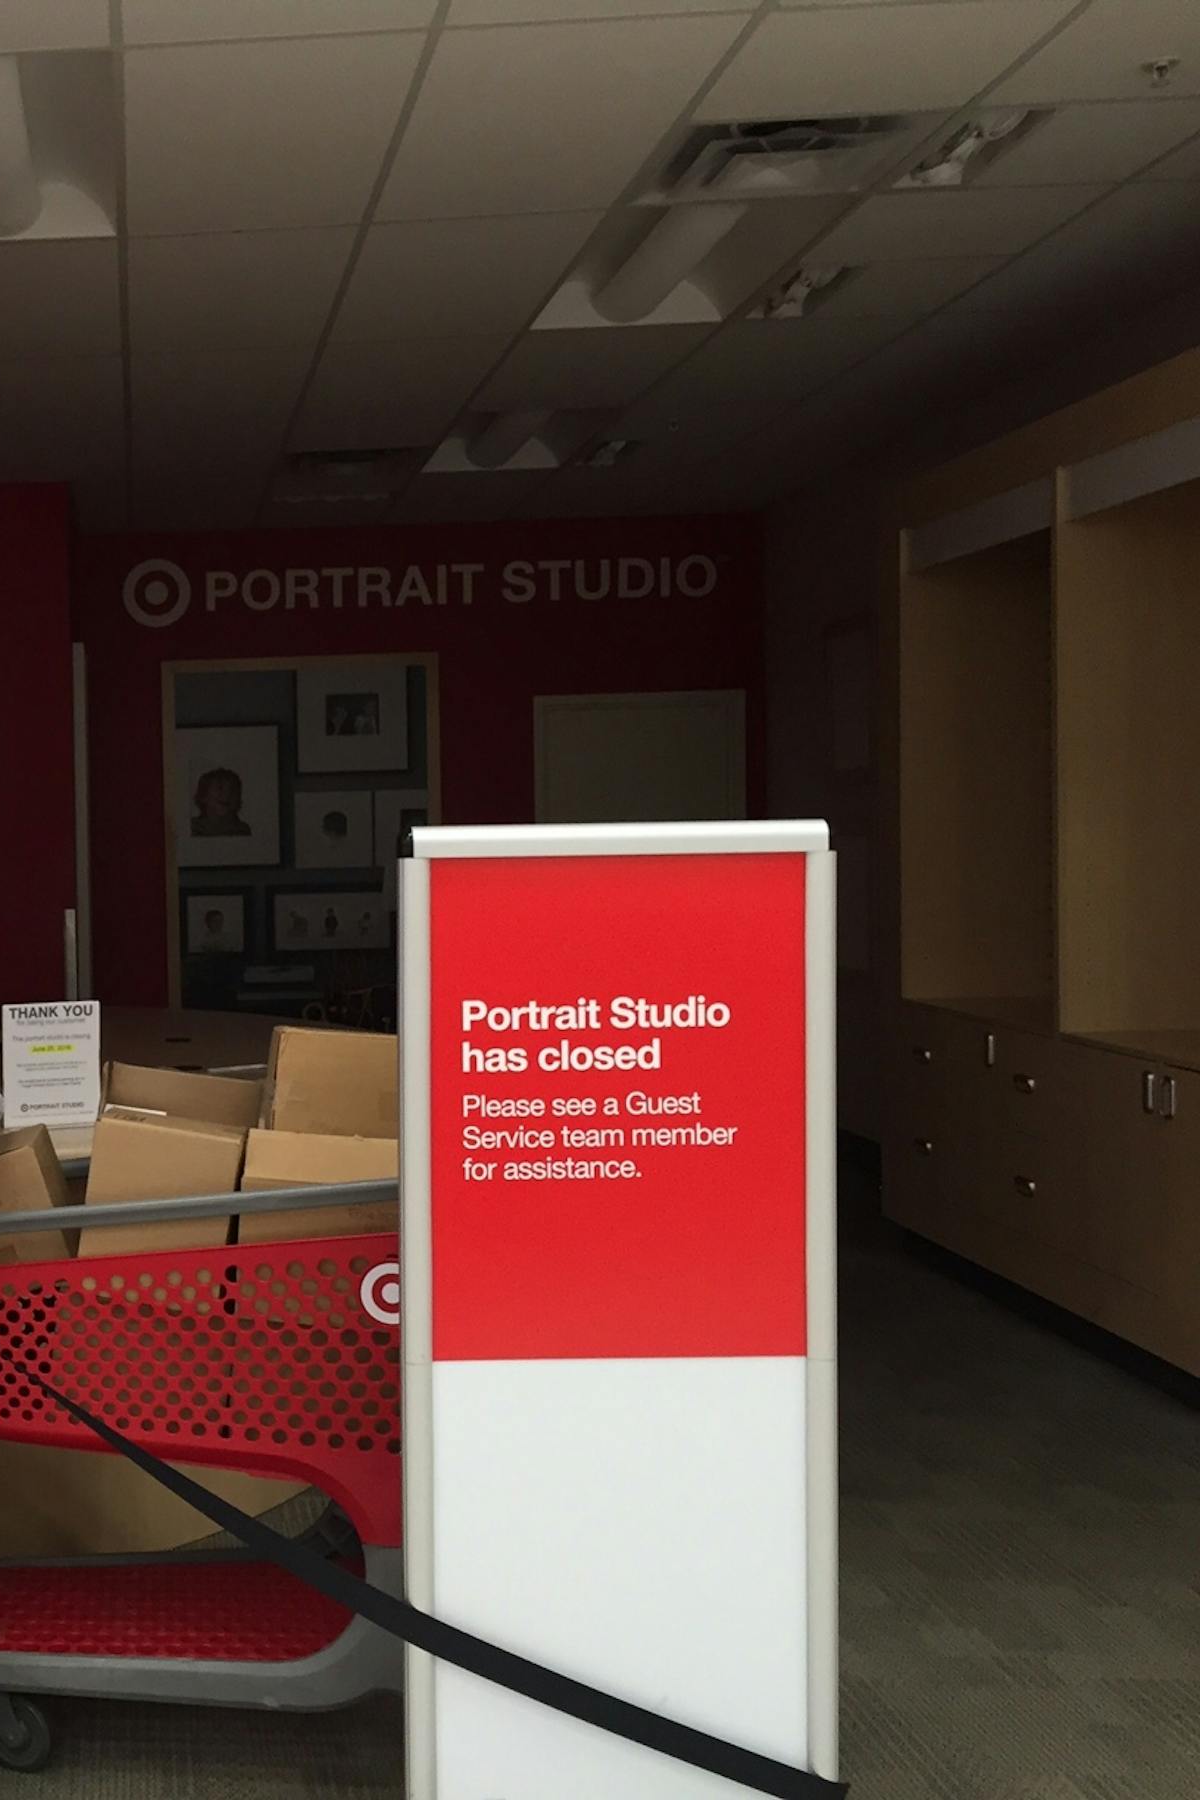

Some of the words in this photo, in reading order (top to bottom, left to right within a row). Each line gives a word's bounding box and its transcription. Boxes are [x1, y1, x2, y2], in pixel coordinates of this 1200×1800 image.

[205, 562, 484, 613] PORTRAIT
[500, 553, 718, 604] STUDIO
[8, 1007, 59, 1020] THANK
[63, 1004, 94, 1018] YOU
[461, 998, 601, 1032] Portrait
[609, 995, 732, 1030] Studio
[461, 1041, 528, 1073] has
[537, 1038, 661, 1072] closed
[462, 1094, 545, 1119] Please
[551, 1096, 597, 1117] see
[602, 1096, 619, 1117] a
[625, 1090, 701, 1116] Guest
[462, 1125, 555, 1150] Service
[560, 1126, 625, 1148] team
[631, 1122, 738, 1147] member
[462, 1157, 499, 1181] for
[502, 1156, 643, 1181] assistance.
